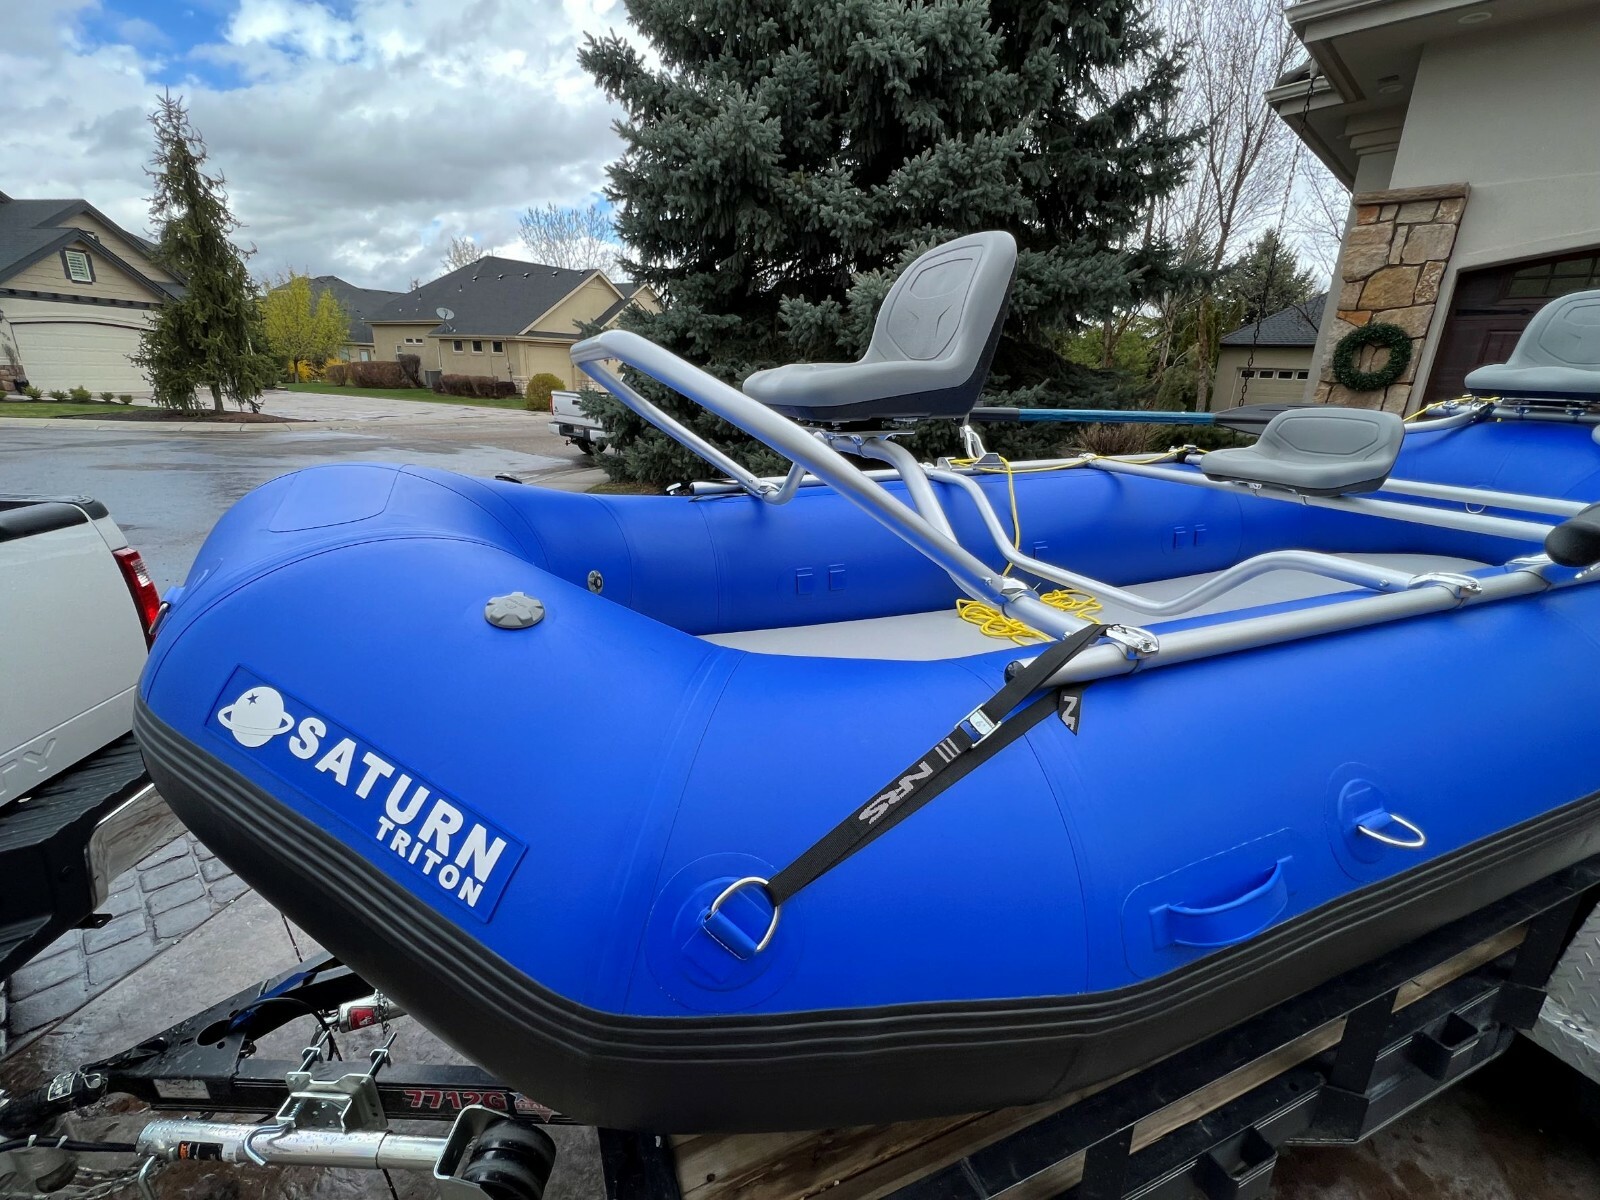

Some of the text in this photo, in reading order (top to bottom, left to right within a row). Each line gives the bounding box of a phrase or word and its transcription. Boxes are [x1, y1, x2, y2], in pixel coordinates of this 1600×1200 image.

[289, 717, 507, 883] SATURN
[859, 761, 933, 824] NRS
[375, 815, 483, 907] TRITON
[403, 1090, 508, 1110] 7712G
